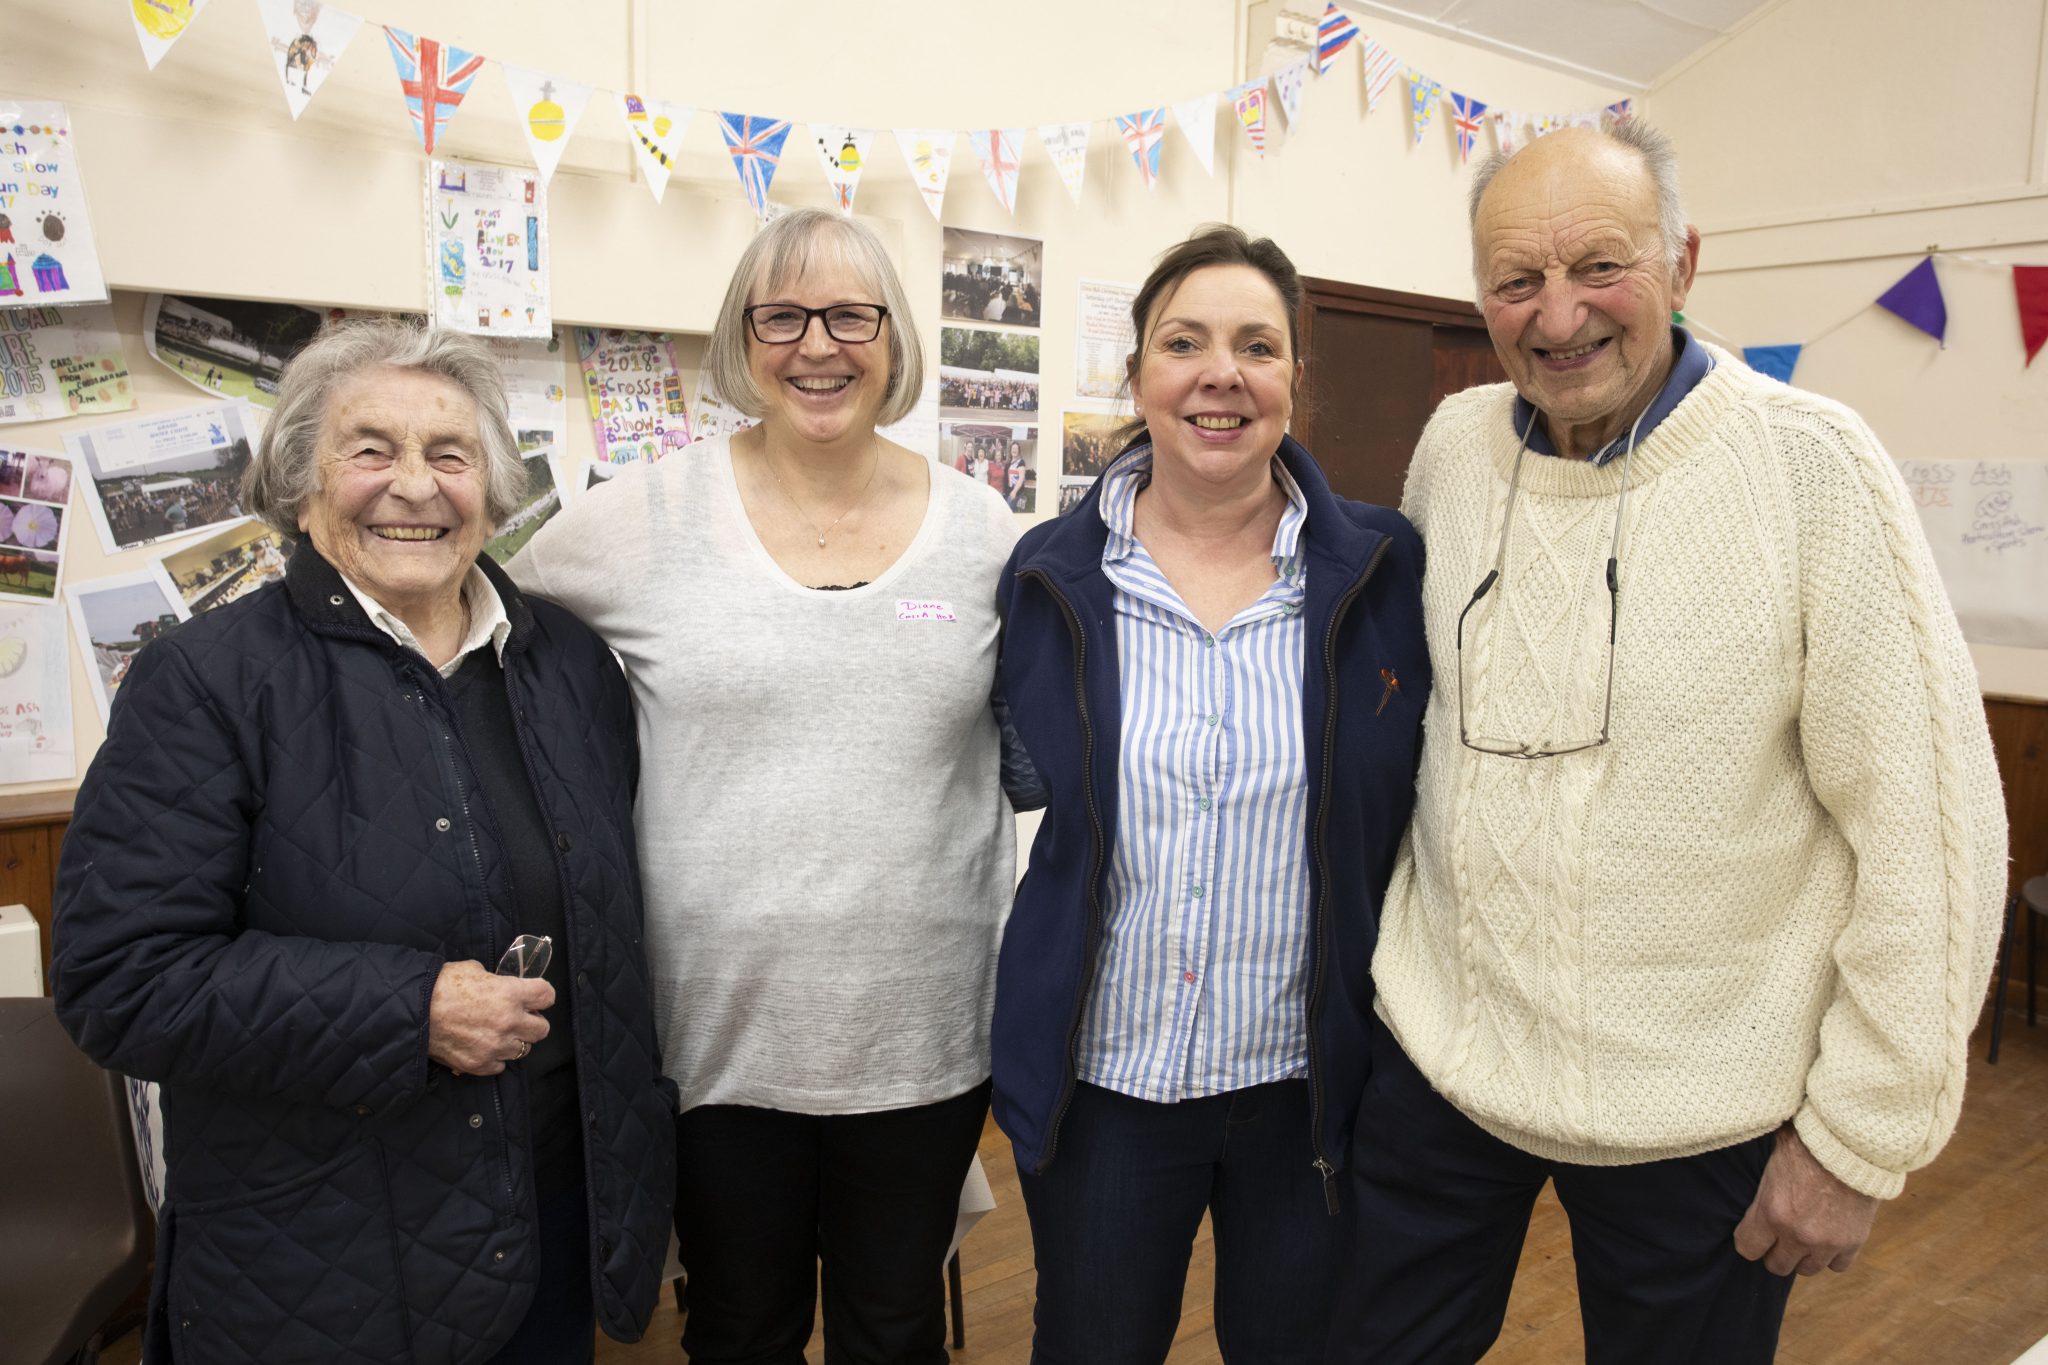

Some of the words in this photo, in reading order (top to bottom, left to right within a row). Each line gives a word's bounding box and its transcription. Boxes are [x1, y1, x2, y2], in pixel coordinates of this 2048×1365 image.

[0, 142, 27, 155] sh
[27, 181, 59, 199] Day
[606, 351, 652, 373] 2018
[900, 601, 944, 611] Diane
